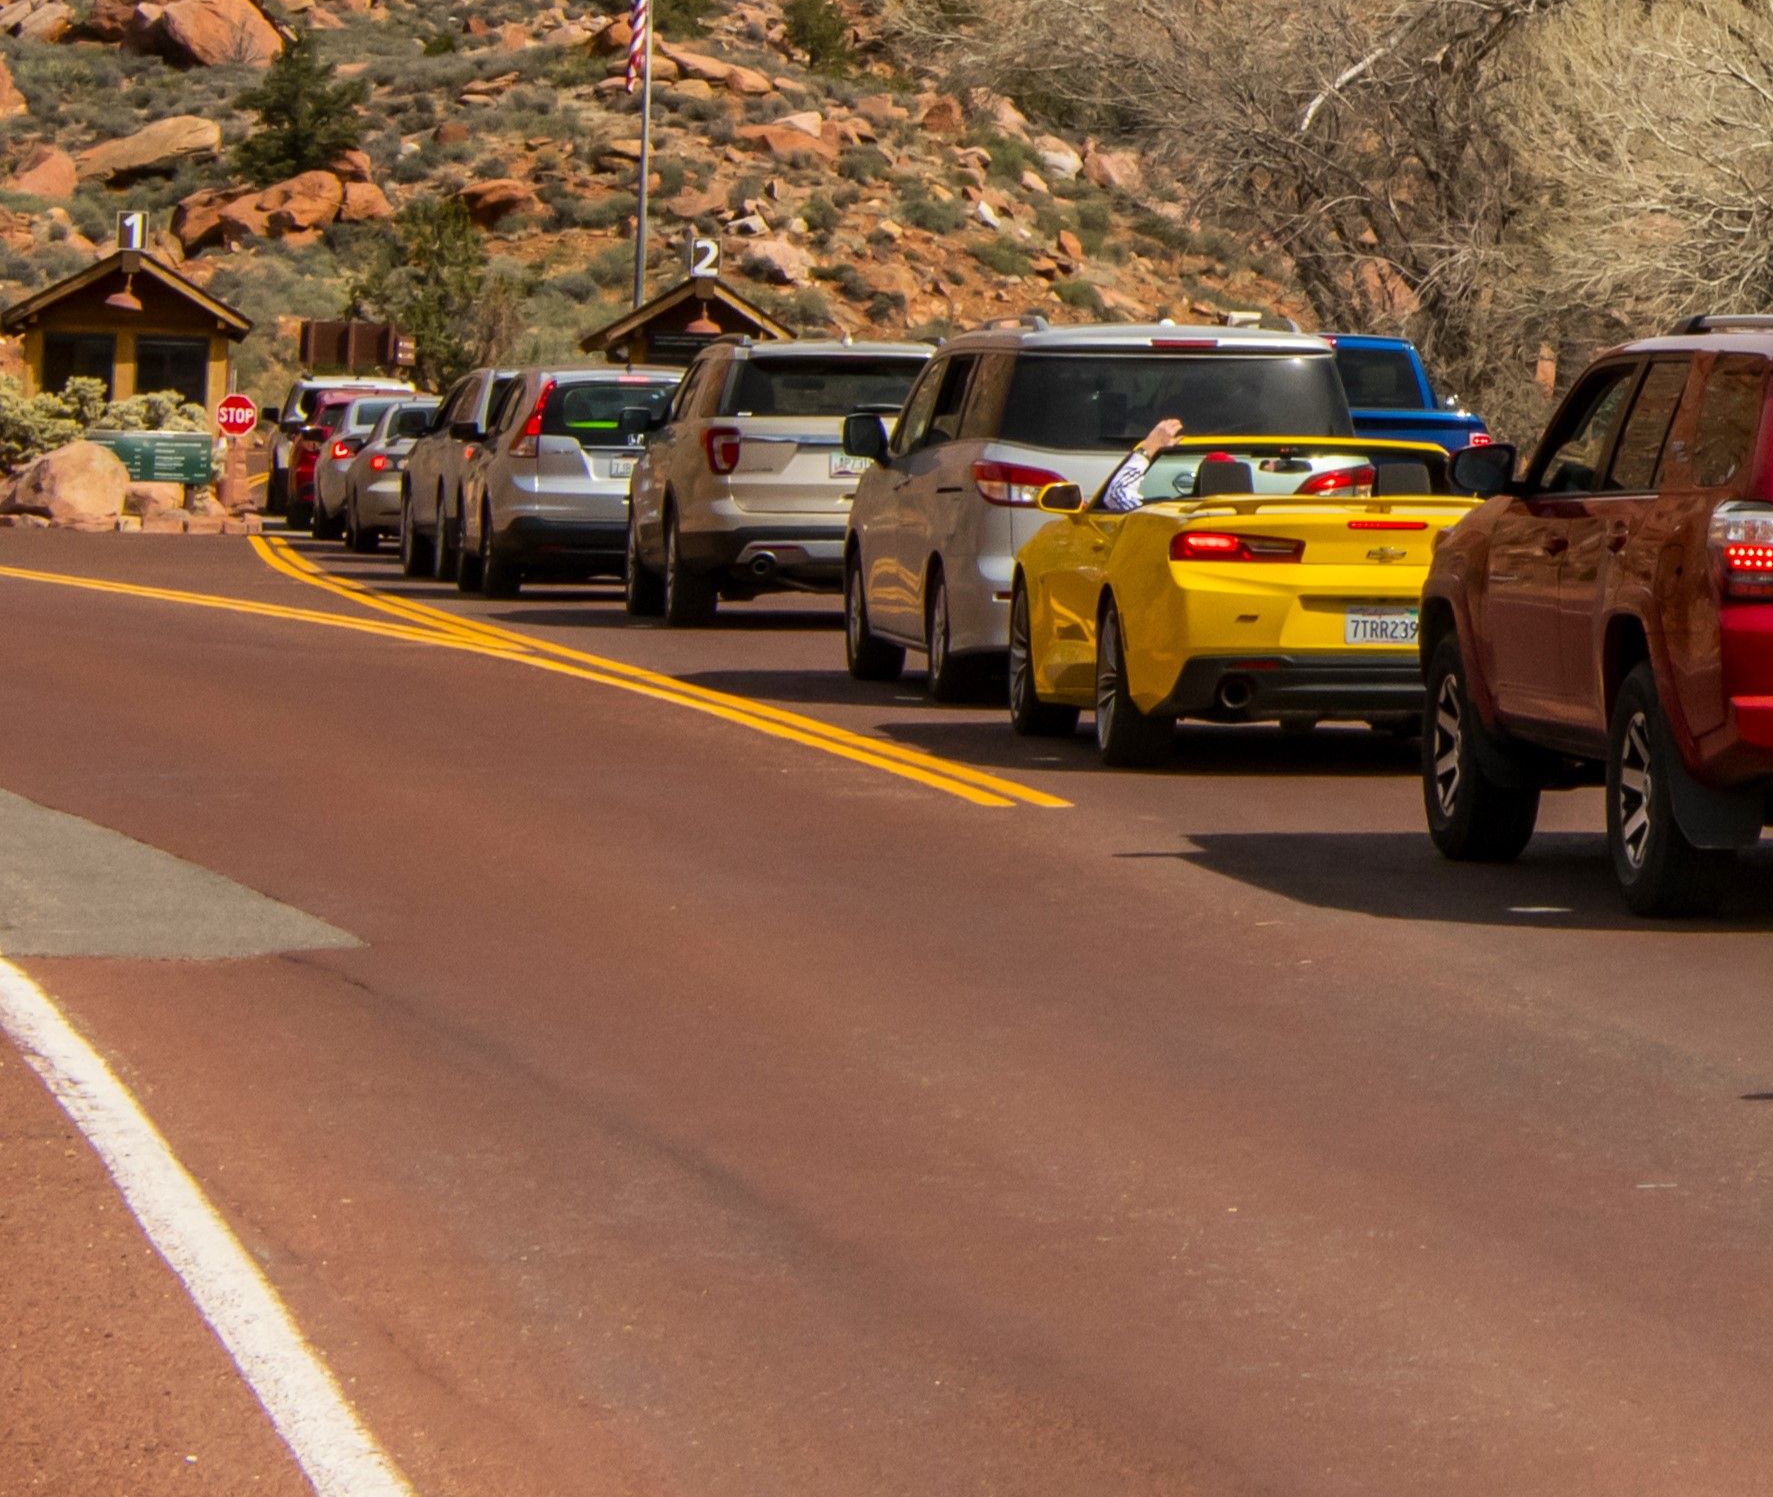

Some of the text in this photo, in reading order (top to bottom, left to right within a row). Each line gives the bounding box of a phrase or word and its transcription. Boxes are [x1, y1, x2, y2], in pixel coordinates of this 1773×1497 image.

[123, 212, 143, 249] 1
[694, 239, 719, 277] 2
[218, 407, 254, 424] STOP
[1351, 619, 1419, 639] 7TRR239
